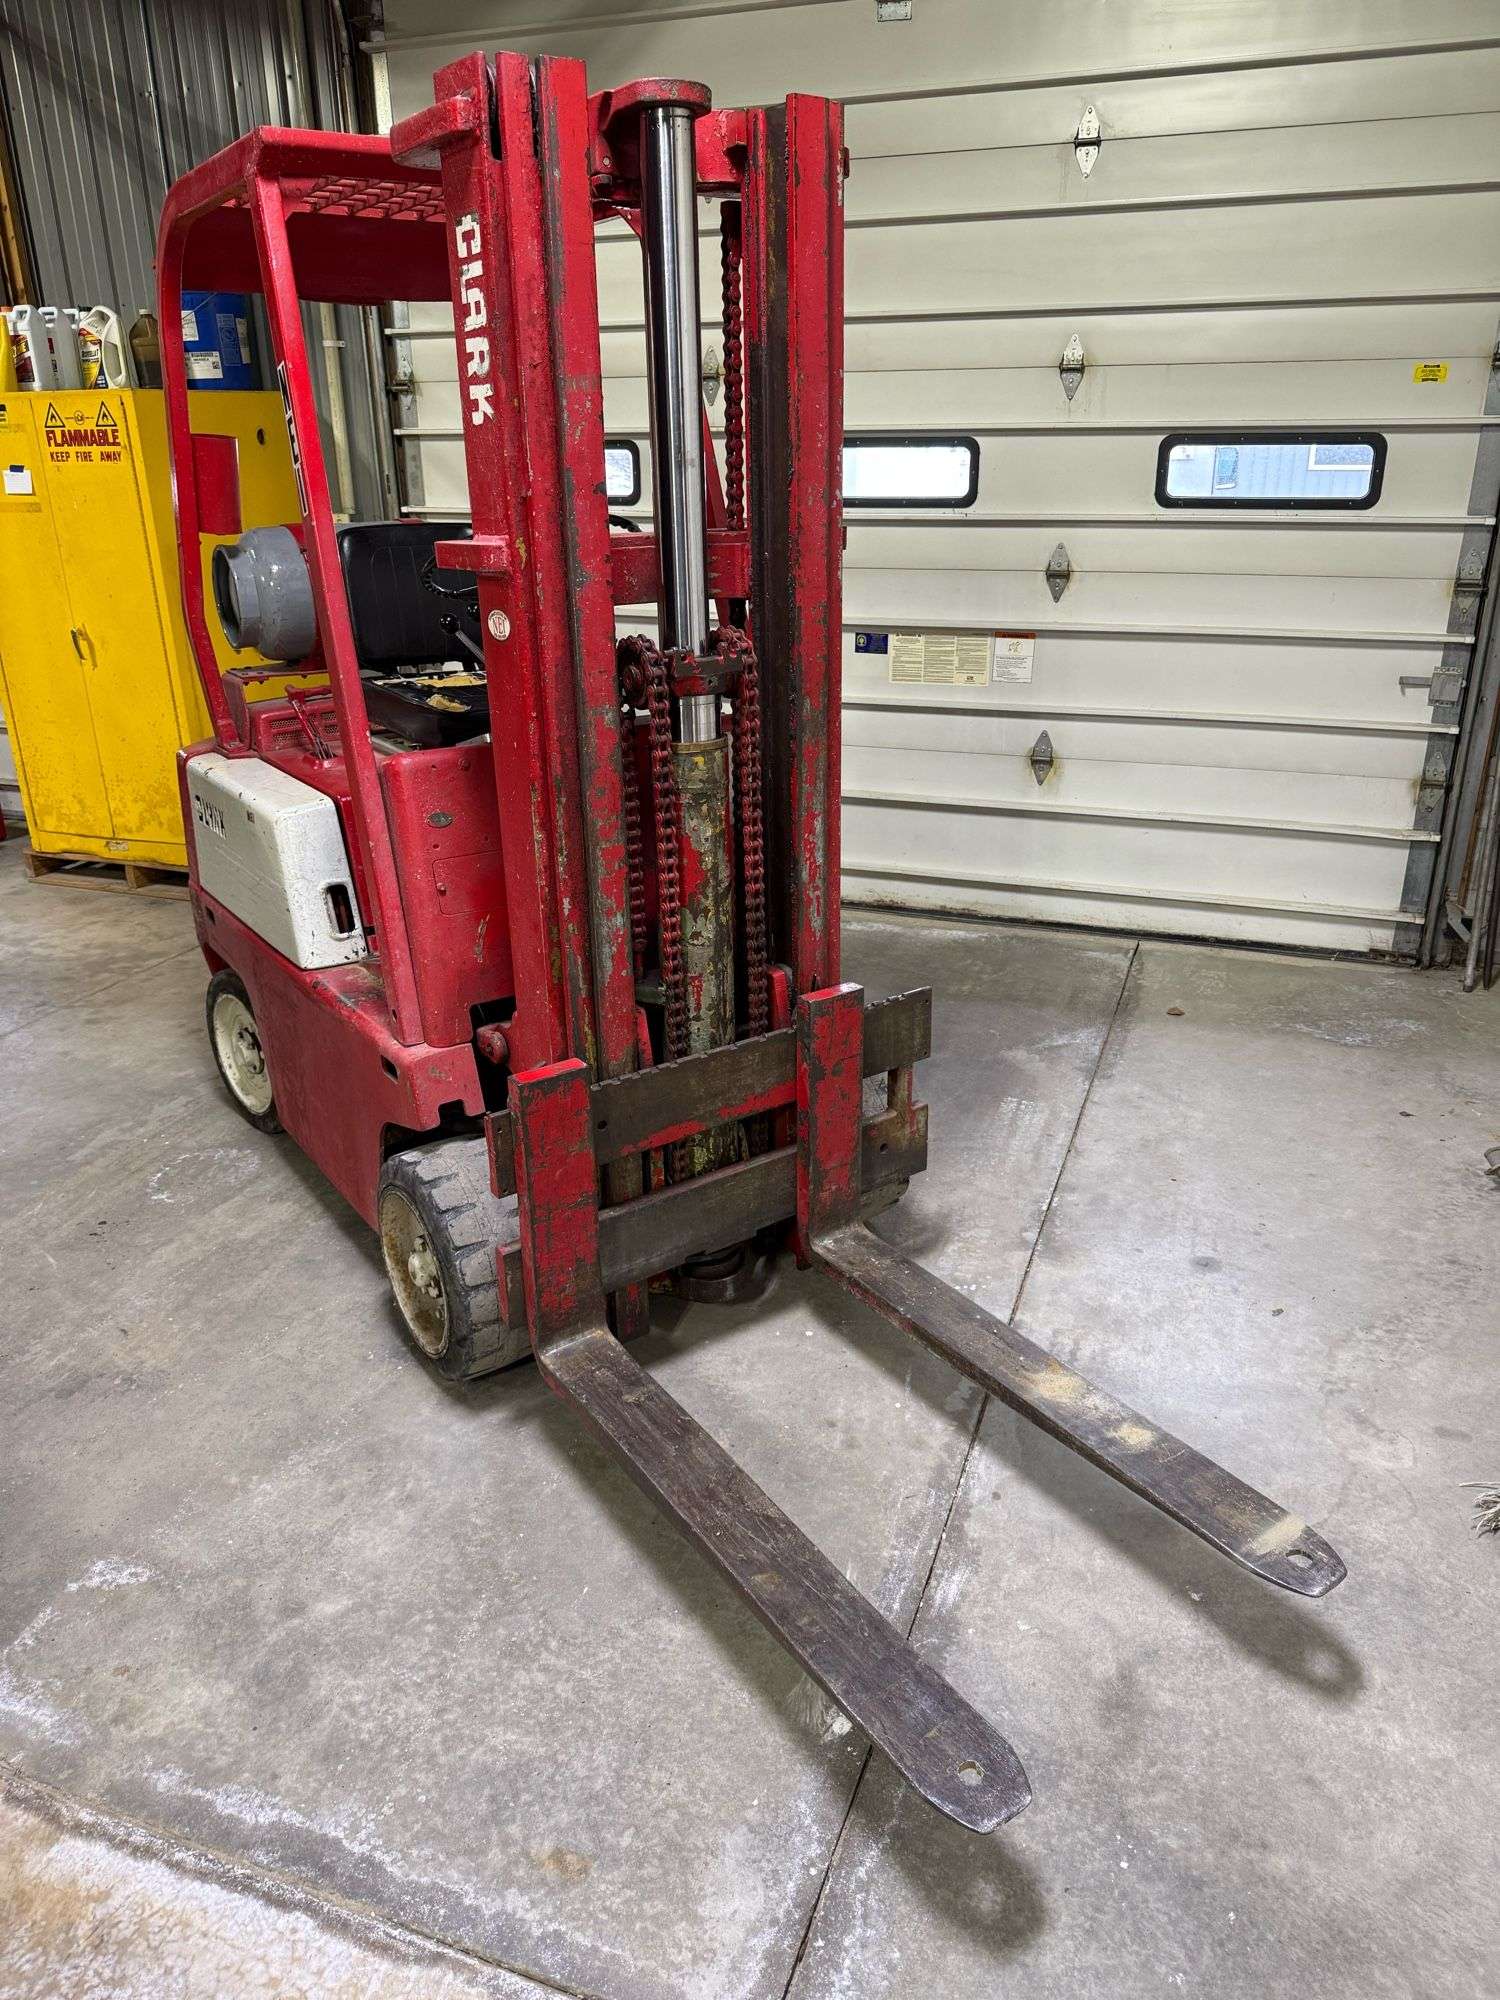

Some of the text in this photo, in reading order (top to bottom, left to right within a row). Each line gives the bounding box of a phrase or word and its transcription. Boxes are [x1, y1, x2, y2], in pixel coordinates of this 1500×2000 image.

[455, 214, 494, 426] CLARK
[45, 429, 120, 447] FLAMMABLE
[50, 450, 121, 462] KEEP FIRE AWAY
